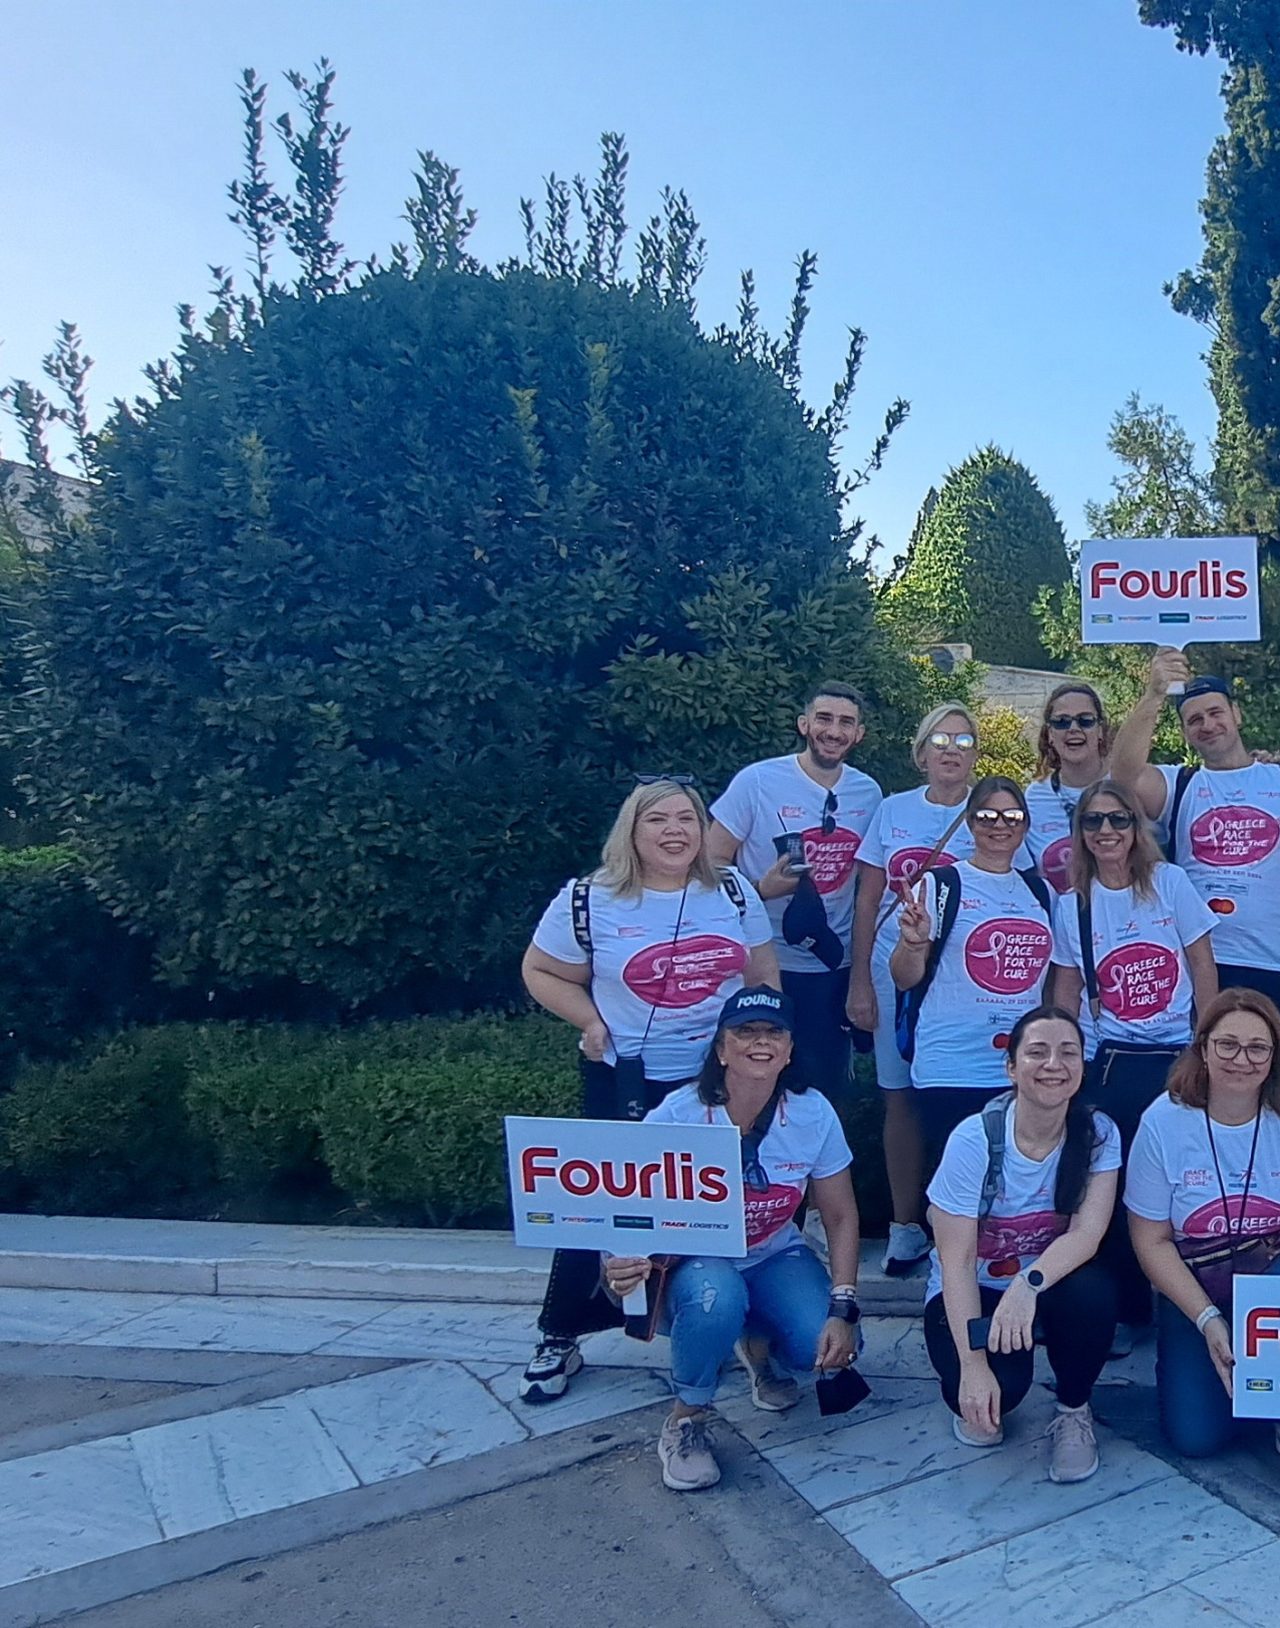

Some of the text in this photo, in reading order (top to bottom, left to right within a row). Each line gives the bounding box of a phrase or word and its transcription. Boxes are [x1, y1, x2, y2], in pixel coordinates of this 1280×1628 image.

[1091, 561, 1248, 599] Fourlis
[1225, 819, 1266, 830] GREECE
[1223, 830, 1252, 840] RACE
[1006, 934, 1048, 945] GREECE
[1005, 946, 1035, 956] RACE
[1004, 957, 1045, 968] FOR THE
[1125, 956, 1167, 974] GREECE
[1003, 969, 1029, 980] CURE
[1127, 970, 1156, 985] RACE
[1129, 977, 1171, 997] FOR THE
[737, 994, 781, 1009] FOURLIS
[1130, 994, 1158, 1007] CURE
[522, 1147, 728, 1202] Fourlis
